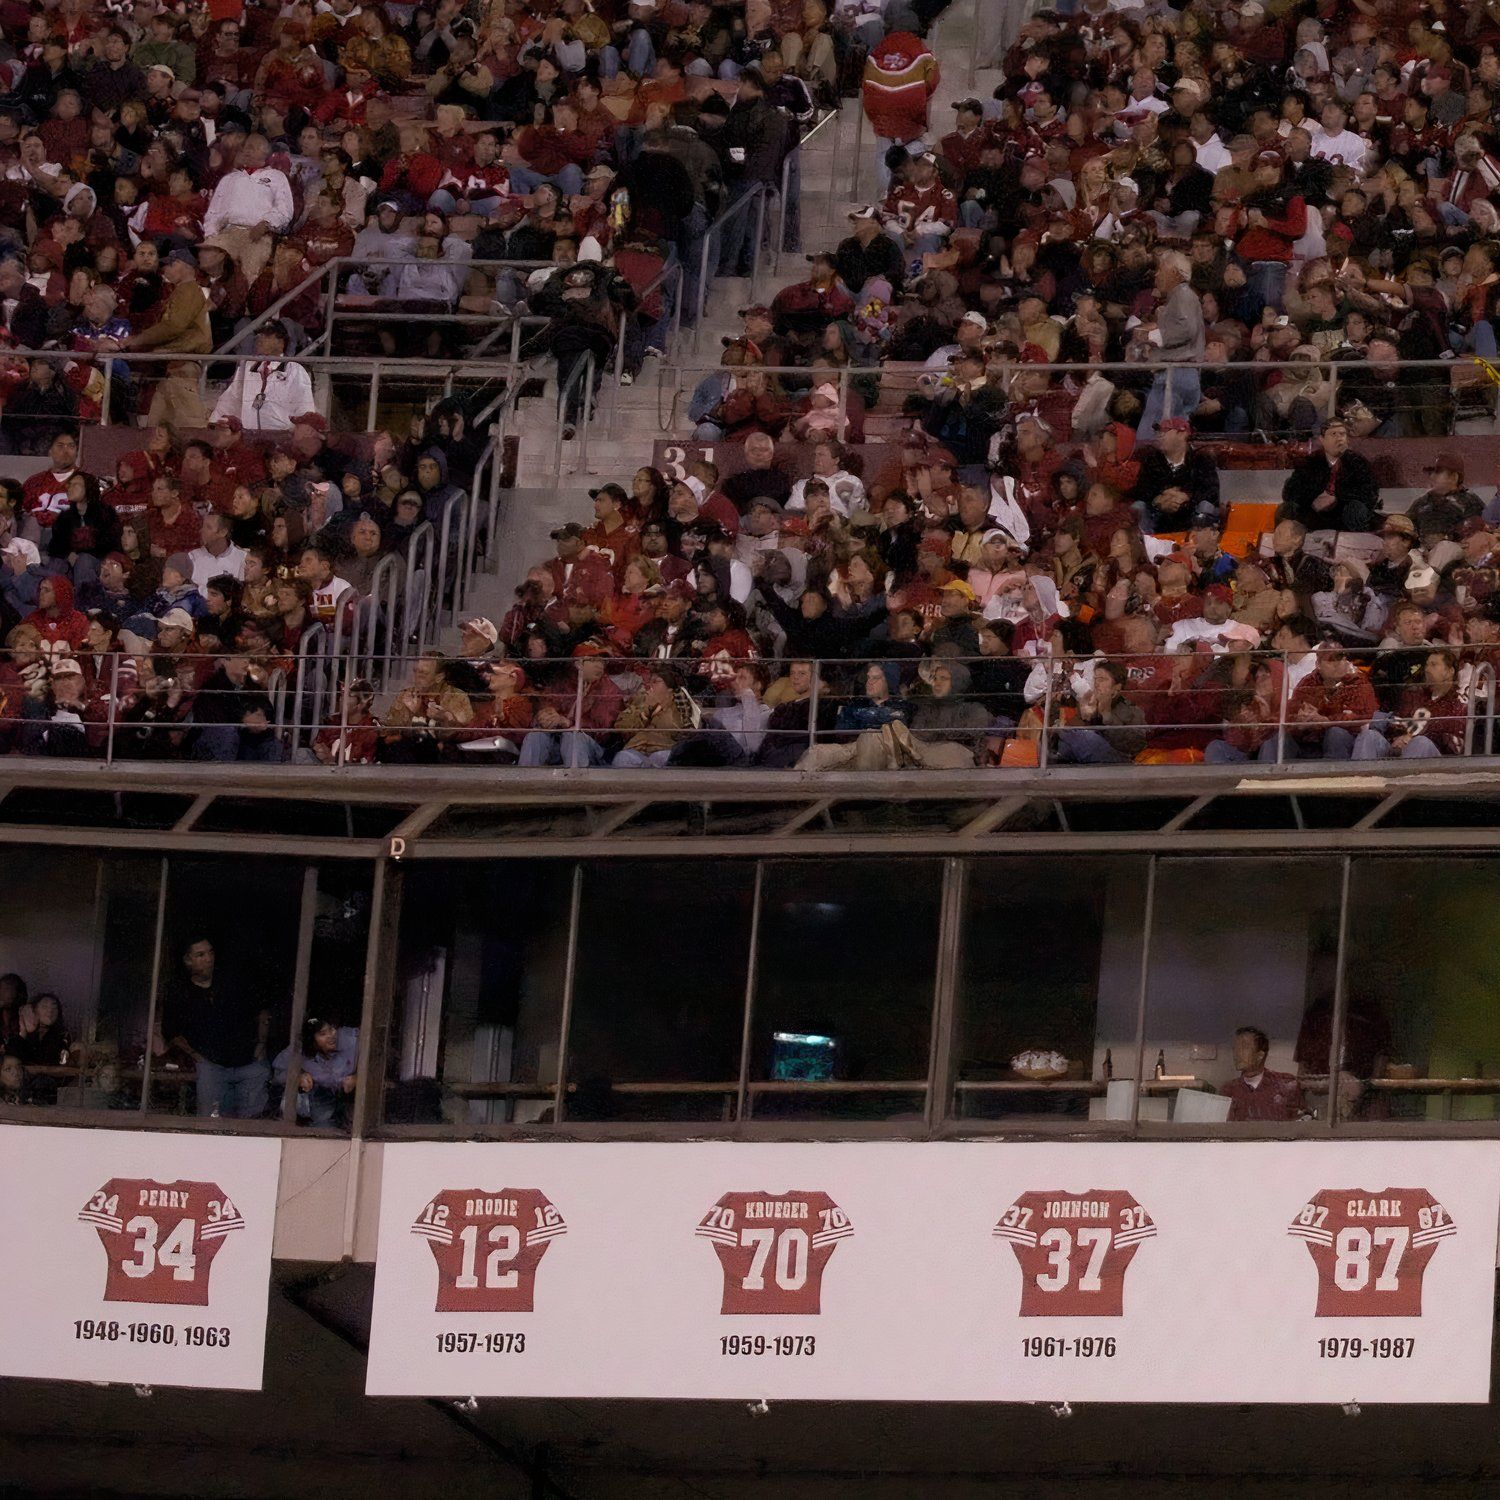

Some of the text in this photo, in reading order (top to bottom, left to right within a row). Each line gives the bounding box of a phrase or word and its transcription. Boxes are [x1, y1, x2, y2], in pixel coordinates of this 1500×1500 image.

[391, 837, 405, 856] D
[89, 1191, 119, 1215] 34
[139, 1190, 189, 1208] PERRY
[207, 1198, 236, 1222] 34
[465, 1199, 518, 1216] BRODIE
[745, 1201, 809, 1219] KRUEGER
[1044, 1201, 1110, 1218] JOHNSON
[1347, 1199, 1401, 1217] CLARK
[423, 1203, 449, 1226] 12
[534, 1204, 560, 1228] 12
[706, 1205, 735, 1229] 70
[818, 1207, 848, 1231] 70
[1003, 1205, 1034, 1229] 37
[1120, 1205, 1146, 1230] 37
[1300, 1204, 1329, 1228] 87
[1418, 1204, 1445, 1230] 87
[121, 1216, 196, 1281] 34
[455, 1225, 520, 1288] 12
[741, 1228, 809, 1291] 70
[1036, 1228, 1112, 1292] 37
[1334, 1226, 1409, 1291] 87
[74, 1320, 231, 1347] 1948-1960, 1963
[435, 1333, 526, 1353] 1957-1973
[719, 1335, 816, 1356] 1959-1973
[1022, 1337, 1116, 1358] 1961-1976
[1317, 1337, 1415, 1358] 1979-1987
